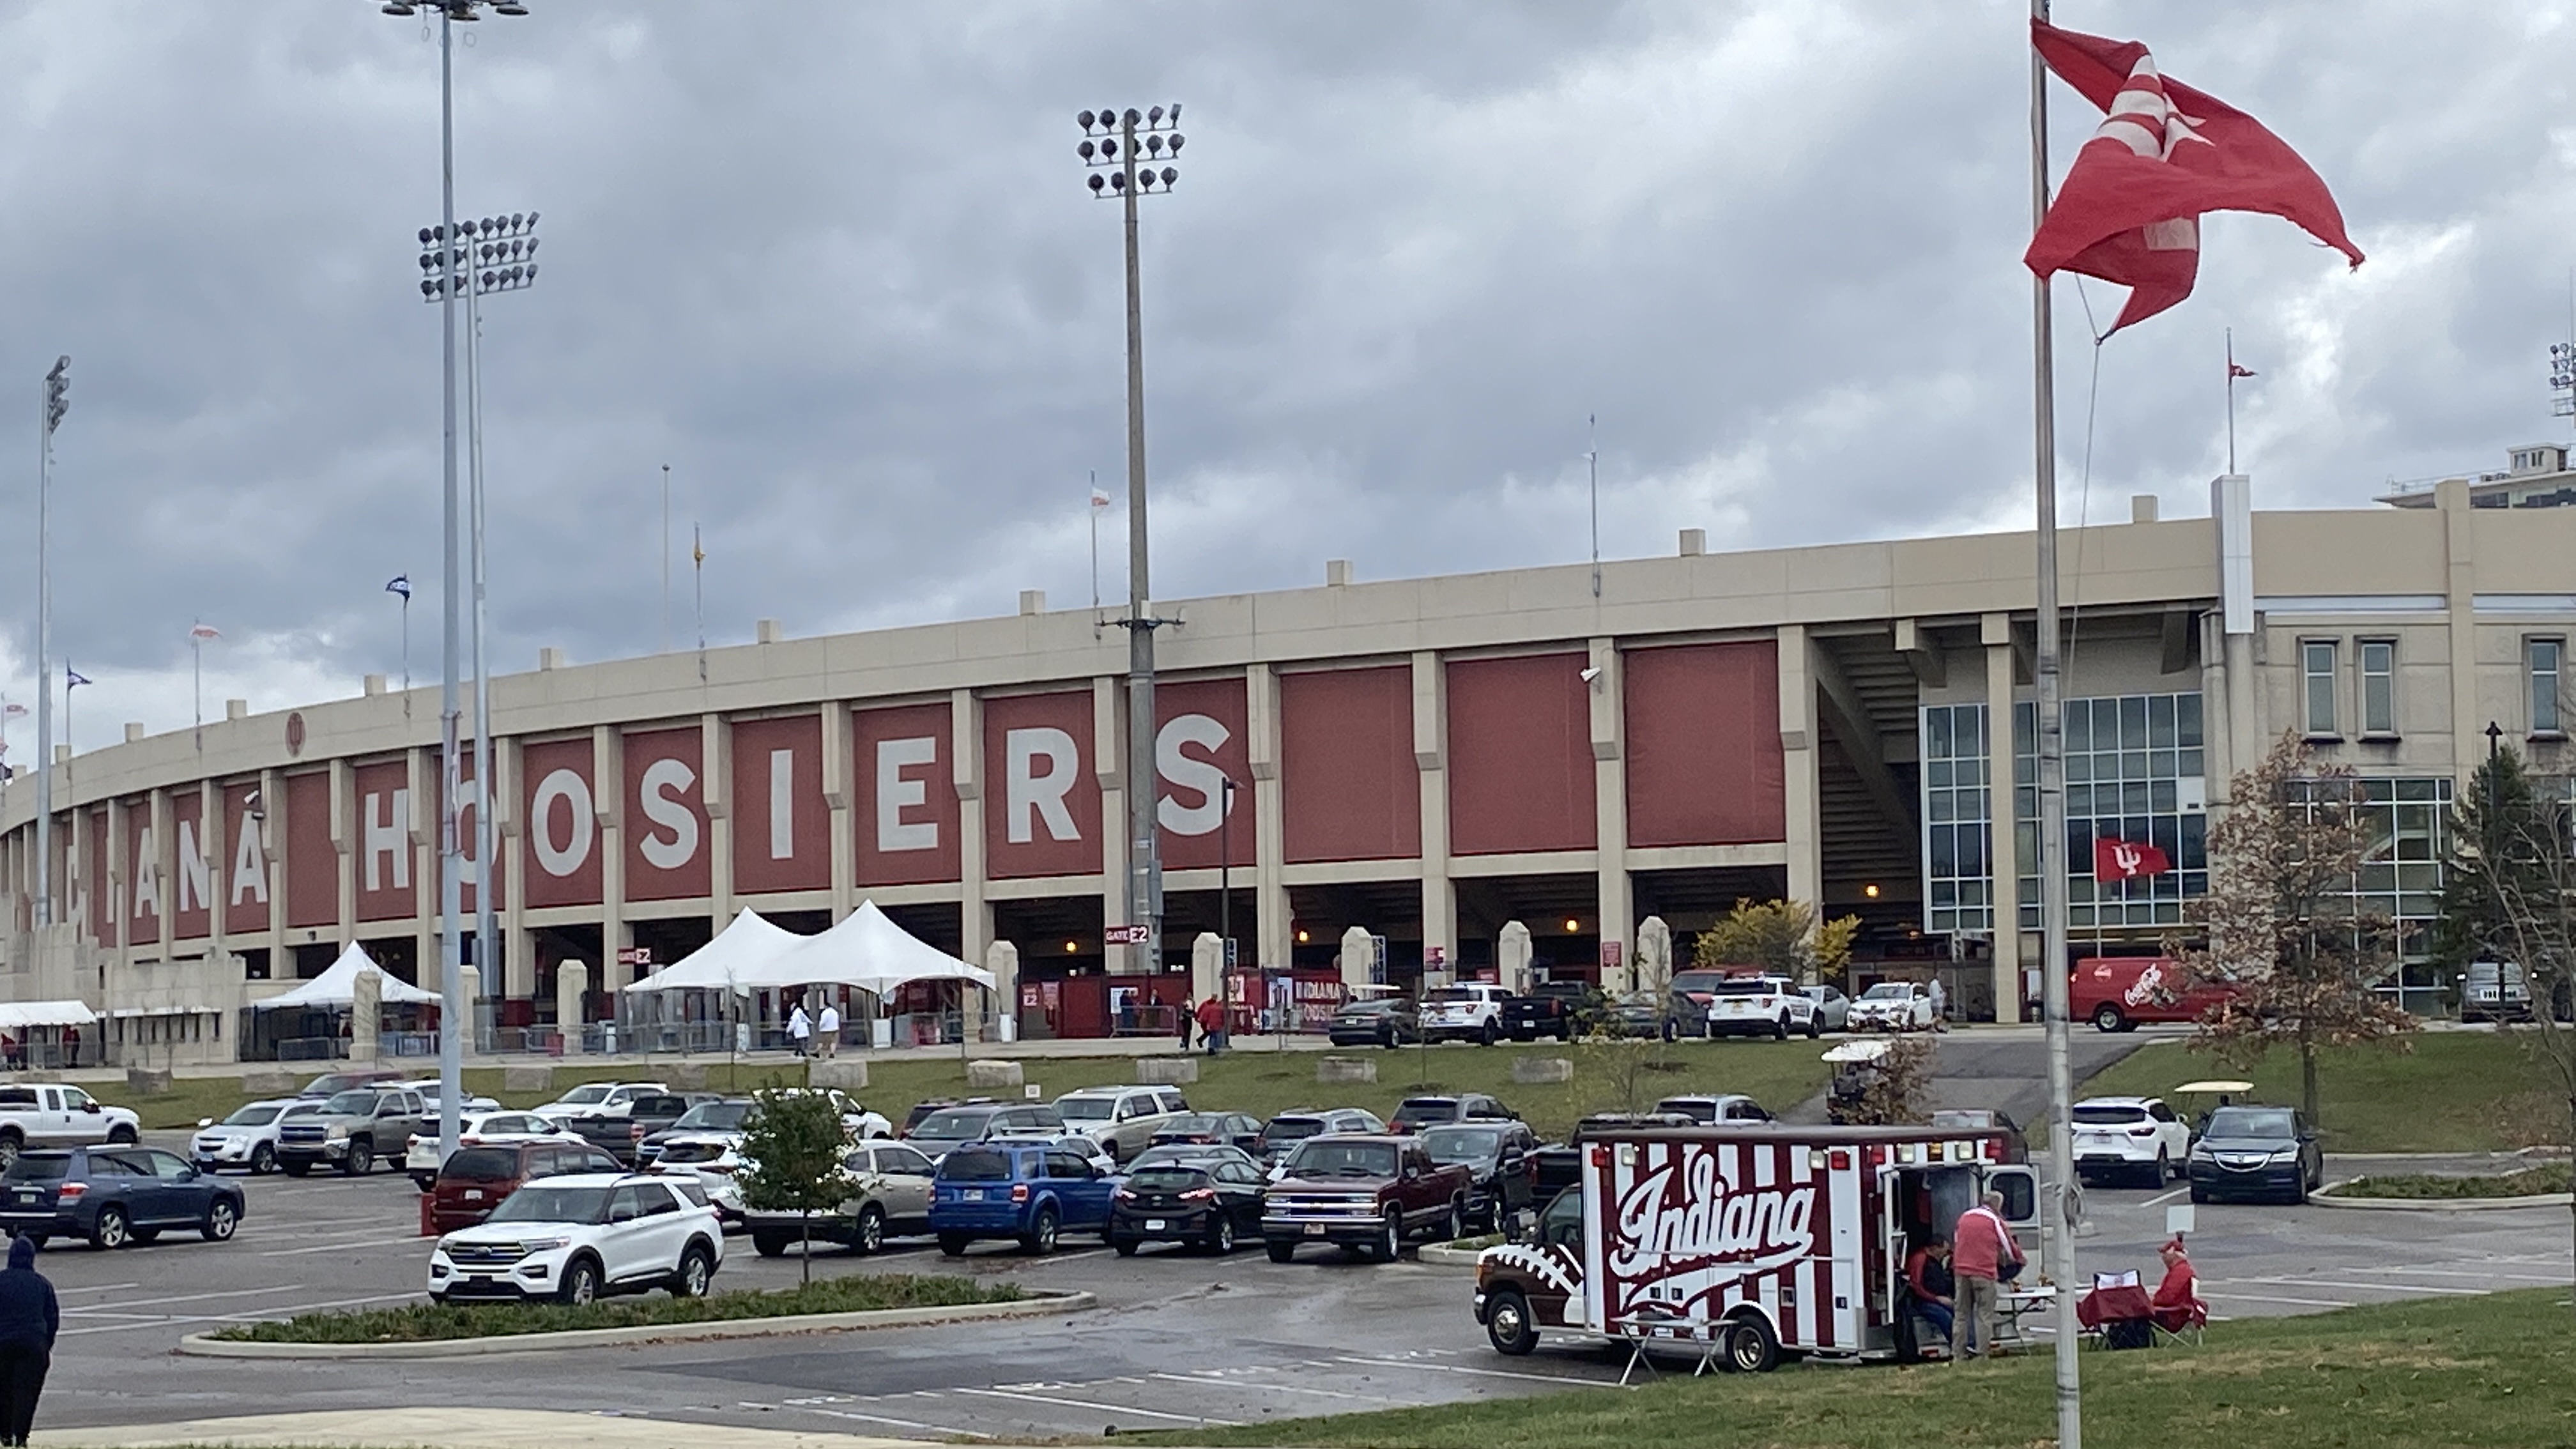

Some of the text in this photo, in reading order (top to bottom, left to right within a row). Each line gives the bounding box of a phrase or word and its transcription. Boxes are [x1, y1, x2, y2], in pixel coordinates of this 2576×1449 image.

[365, 714, 1233, 891] HOOSIERS
[1130, 926, 1147, 943] E2
[1609, 1153, 1816, 1278] Indiana
